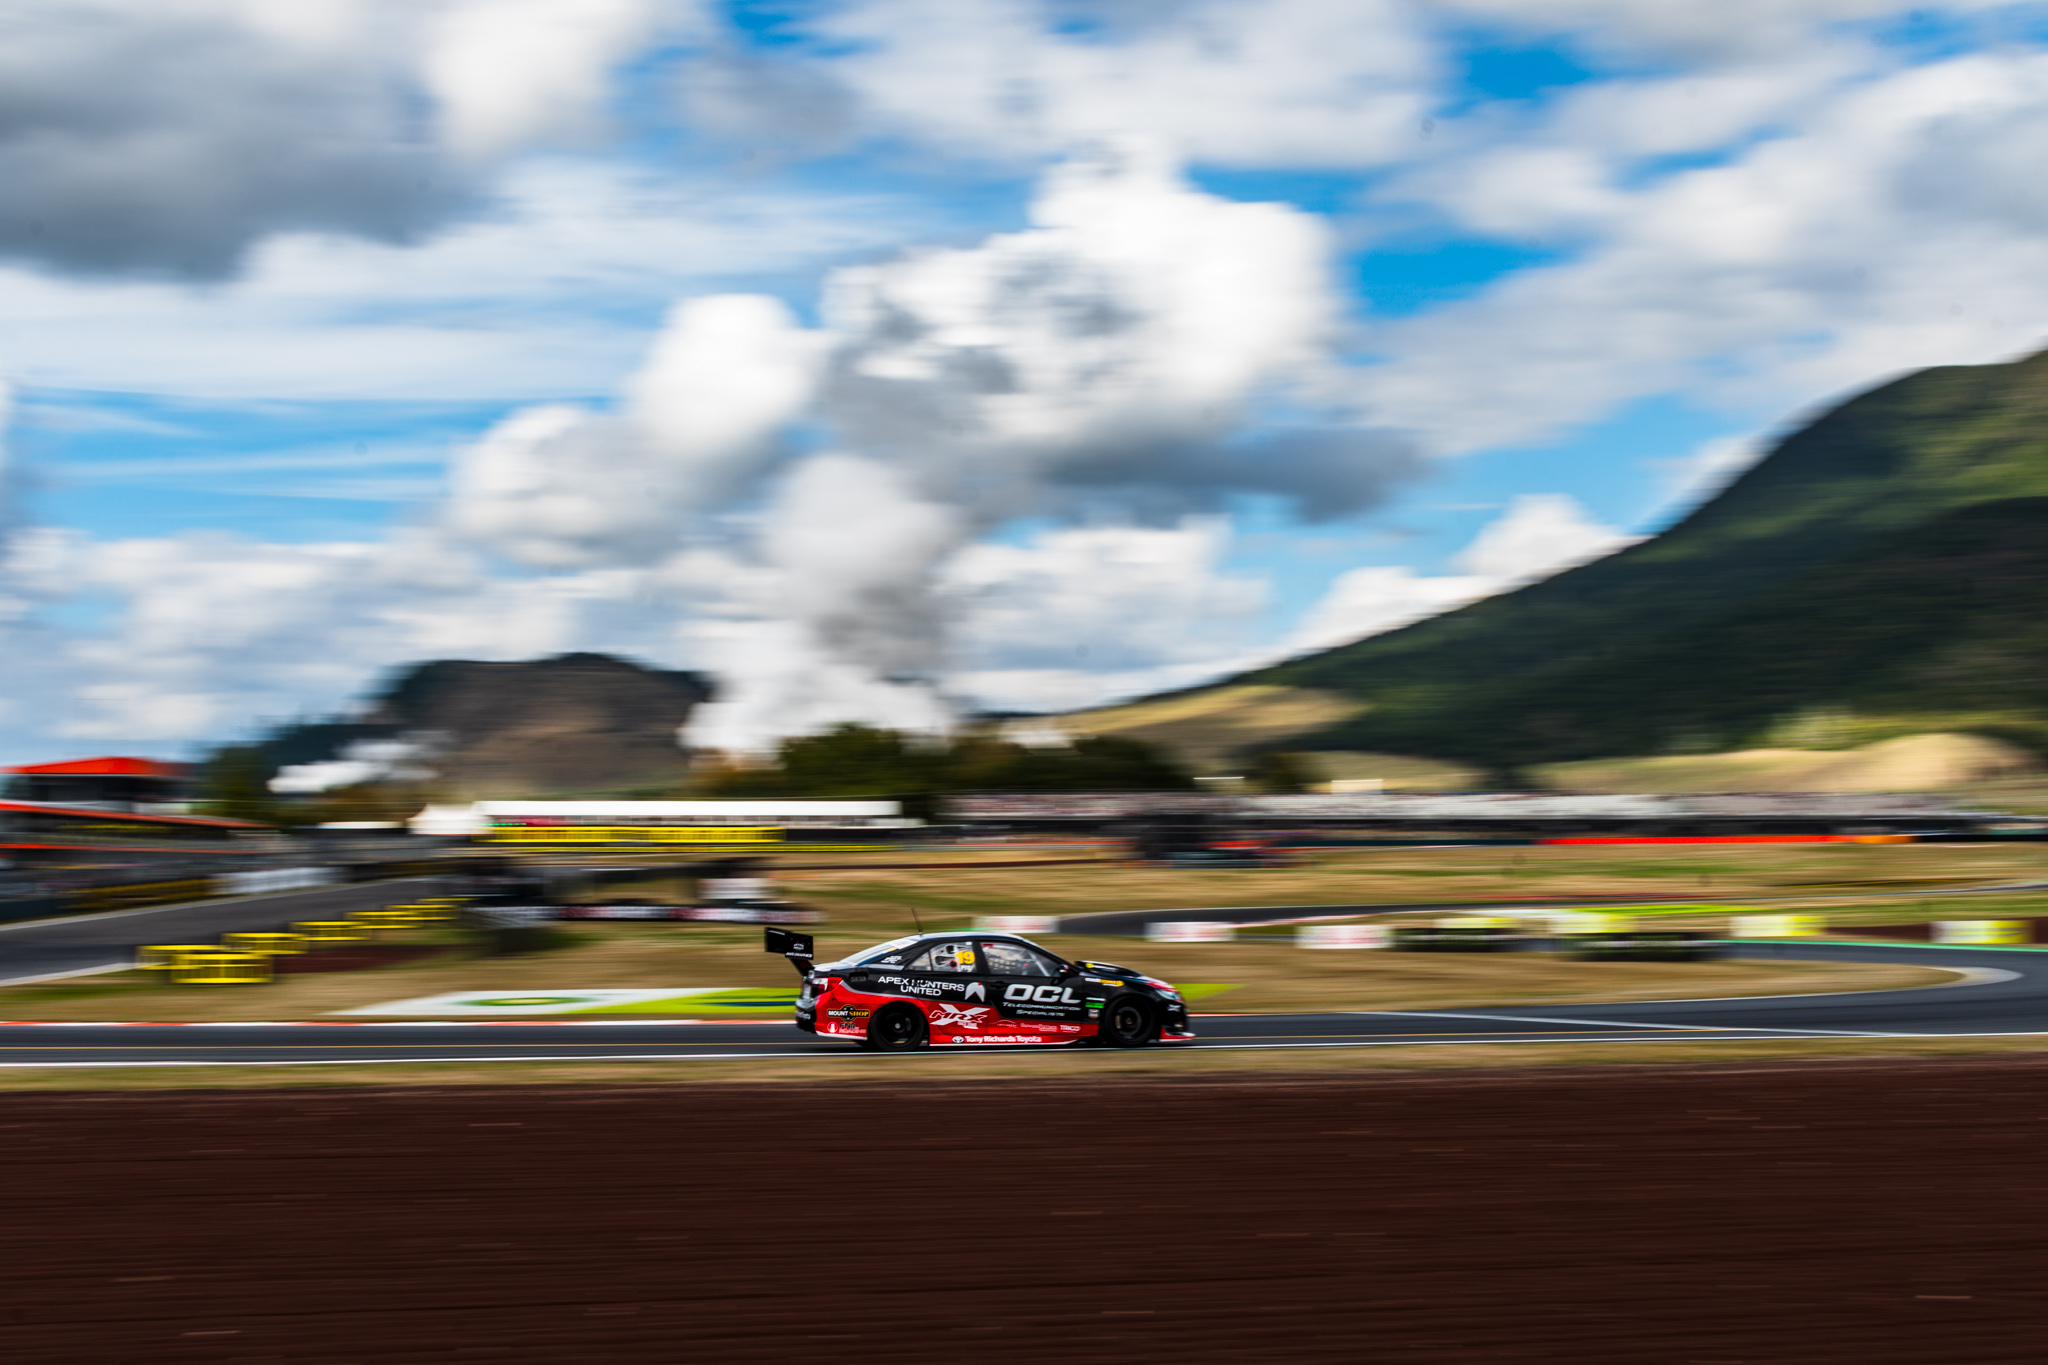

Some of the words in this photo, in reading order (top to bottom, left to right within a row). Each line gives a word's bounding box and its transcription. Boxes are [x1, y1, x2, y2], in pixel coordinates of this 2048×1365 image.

[954, 950, 976, 965] 19
[878, 976, 909, 985] APEX
[900, 985, 942, 996] UNITED
[1003, 984, 1082, 1004] OCL
[929, 1010, 988, 1024] MRX
[1016, 1035, 1042, 1043] Toyota
